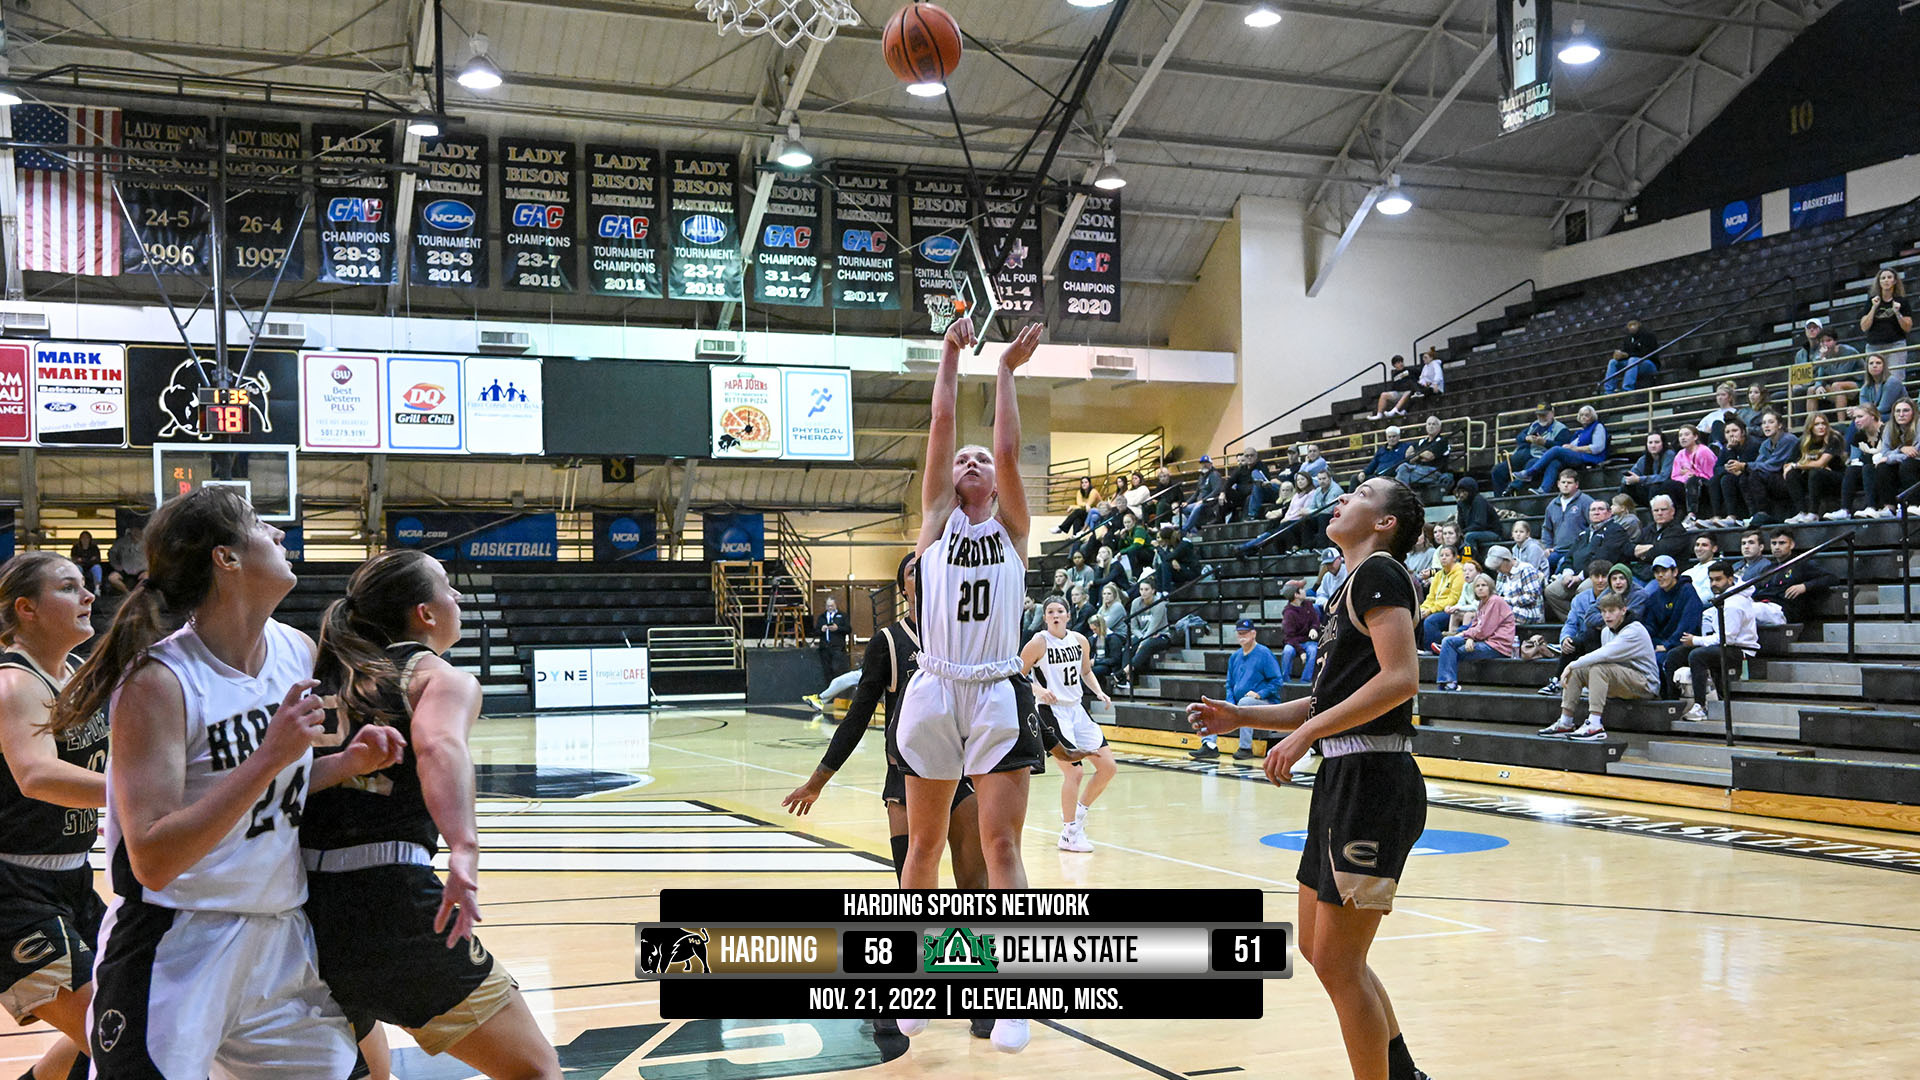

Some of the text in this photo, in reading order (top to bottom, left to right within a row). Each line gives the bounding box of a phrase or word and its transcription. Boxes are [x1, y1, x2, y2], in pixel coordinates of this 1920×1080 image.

[1515, 37, 1534, 60] 30
[1790, 100, 1814, 135] 10
[125, 120, 161, 139] LADY
[229, 129, 300, 149] ADY BISON
[321, 136, 383, 153] LADY
[418, 141, 479, 160] LADY
[507, 146, 566, 165] LADY
[593, 153, 651, 171] LADY
[674, 158, 730, 177] LADY
[505, 167, 570, 186] BISON
[591, 173, 654, 193] BISON
[838, 175, 889, 190] LADY
[415, 179, 483, 196] BASKETBALL
[672, 178, 733, 196] BISON
[771, 185, 817, 202] ISON
[914, 181, 963, 194] LADY
[505, 187, 570, 203] BASKETBALL
[591, 193, 655, 209] BASKETBALL
[837, 192, 892, 208] BISON
[1802, 192, 1844, 211] BASKETBALL
[327, 197, 383, 223] GAC
[672, 198, 734, 214] BASKETBALL
[912, 197, 968, 214] BISON
[145, 208, 190, 228] 24-5
[429, 212, 473, 225] NCAA
[512, 202, 565, 229] GAC
[837, 208, 894, 224] BASKETBALL
[1724, 213, 1748, 228] NCAA
[239, 215, 283, 234] 26-4
[598, 214, 650, 240] GAC
[322, 230, 390, 244] CHAMPIONS
[417, 234, 482, 249] TOURNAMENT
[507, 233, 571, 248] CHAMPIONS
[763, 224, 812, 249] GAC
[842, 229, 888, 254] GAC
[141, 243, 195, 266] 1996
[235, 246, 287, 269] 1997
[517, 251, 561, 268] 23-7
[593, 246, 655, 260] TOURNAMENT
[674, 247, 734, 261] TOURNAMENT
[759, 253, 817, 267] CHAMPIONS
[593, 260, 656, 274] CHAMPIONS
[837, 255, 893, 269] TOURNAMENT
[1068, 250, 1111, 273] GAC
[335, 264, 381, 279] 2014
[428, 268, 473, 283] 2014
[683, 263, 726, 279] 23-7
[765, 270, 812, 283] 31-4
[837, 269, 895, 282] CHAMPIONS
[914, 267, 943, 278] CENTRAL
[1013, 273, 1037, 283] FOUR
[519, 273, 561, 288] 2015
[604, 277, 646, 291] 2015
[1063, 281, 1115, 294] CHAMPIONS
[684, 282, 726, 296] 2015
[765, 285, 811, 299] 2017
[843, 290, 889, 303] 2017
[1067, 297, 1112, 315] 2020
[38, 351, 102, 364] MARK
[38, 367, 122, 381] MARTIN
[333, 369, 351, 380] BW
[332, 386, 352, 395] Best
[724, 379, 743, 390] PAPA
[323, 394, 361, 403] Western
[409, 388, 441, 406] DQ
[48, 402, 73, 412] Ford
[330, 403, 355, 411] PLUS
[398, 529, 448, 538] NCAA.com
[612, 533, 640, 542] NCAA
[470, 542, 552, 557] BASKETBALL
[720, 543, 751, 553] NCAA
[957, 579, 990, 622] 20
[537, 669, 588, 682] DYNE
[623, 668, 645, 680] CAFE
[1063, 666, 1078, 687] 12
[245, 765, 305, 839] 24
